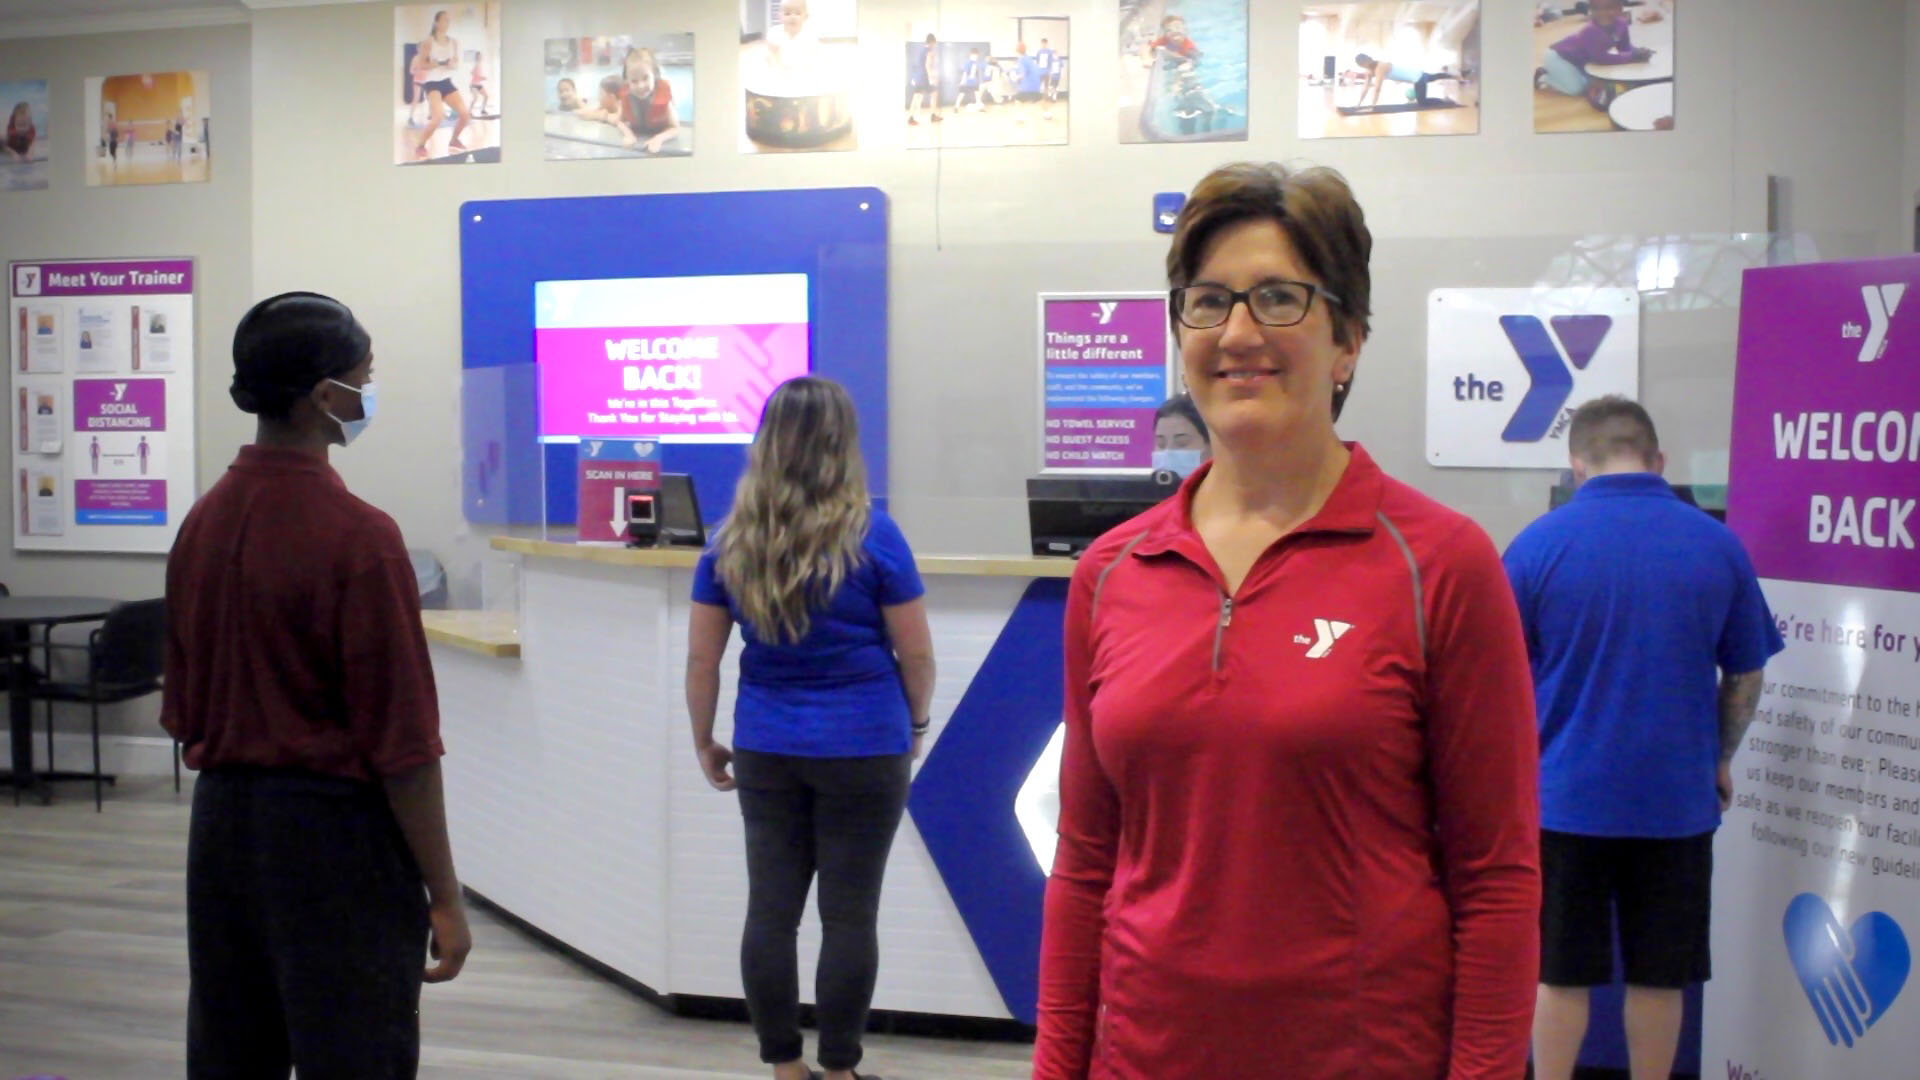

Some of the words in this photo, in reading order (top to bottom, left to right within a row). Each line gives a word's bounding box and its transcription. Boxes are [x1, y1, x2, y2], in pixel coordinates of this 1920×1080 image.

[49, 272, 86, 287] Meet
[90, 271, 125, 286] Your
[129, 270, 184, 285] Trainer
[1046, 332, 1091, 347] Things
[1095, 334, 1117, 344] are
[1120, 334, 1128, 344] a
[1842, 321, 1862, 338] the
[605, 337, 719, 360] WELCOME
[1046, 348, 1079, 360] little
[1082, 347, 1143, 360] different
[623, 365, 702, 390] BACK!
[1453, 372, 1504, 401] the
[1499, 314, 1613, 443] Y
[100, 403, 138, 414] SOCIAL
[87, 417, 152, 428] DISTANCING
[1046, 419, 1060, 428] NO
[1062, 419, 1095, 428] TOWEL
[1096, 419, 1135, 428] SERVICE
[1046, 435, 1060, 444] NO
[1062, 435, 1092, 444] GUEST
[1095, 435, 1130, 444] ACCESS
[1046, 451, 1060, 460] NO
[1062, 451, 1089, 460] CHILD
[1091, 451, 1124, 460] WATCH
[585, 470, 612, 480] SCAN
[614, 470, 625, 480] IN
[627, 471, 653, 480] HERE
[1808, 495, 1916, 549] BACK
[1293, 633, 1311, 645] the
[1776, 614, 1815, 642] e're
[1821, 618, 1867, 648] here
[1873, 624, 1906, 652] for
[1762, 682, 1776, 695] ur
[1780, 683, 1862, 710] commitment
[1867, 694, 1882, 712] to
[1887, 695, 1910, 717] the
[1756, 708, 1773, 724] nd
[1777, 711, 1816, 736] safety
[1820, 718, 1835, 734] of
[1840, 724, 1862, 740] our
[1749, 736, 1801, 763] stronger
[1807, 745, 1837, 765] than
[1746, 766, 1761, 782] us
[1765, 769, 1794, 792] keep
[1798, 776, 1821, 793] our
[1825, 782, 1887, 809] members
[1892, 796, 1920, 815] and
[1736, 792, 1762, 811] safe
[1766, 800, 1780, 815] as
[1784, 805, 1801, 821] we
[1806, 809, 1853, 833] reopen
[1857, 820, 1881, 838] our
[1751, 821, 1808, 857] following
[1812, 840, 1834, 858] our
[1840, 848, 1867, 866] new
